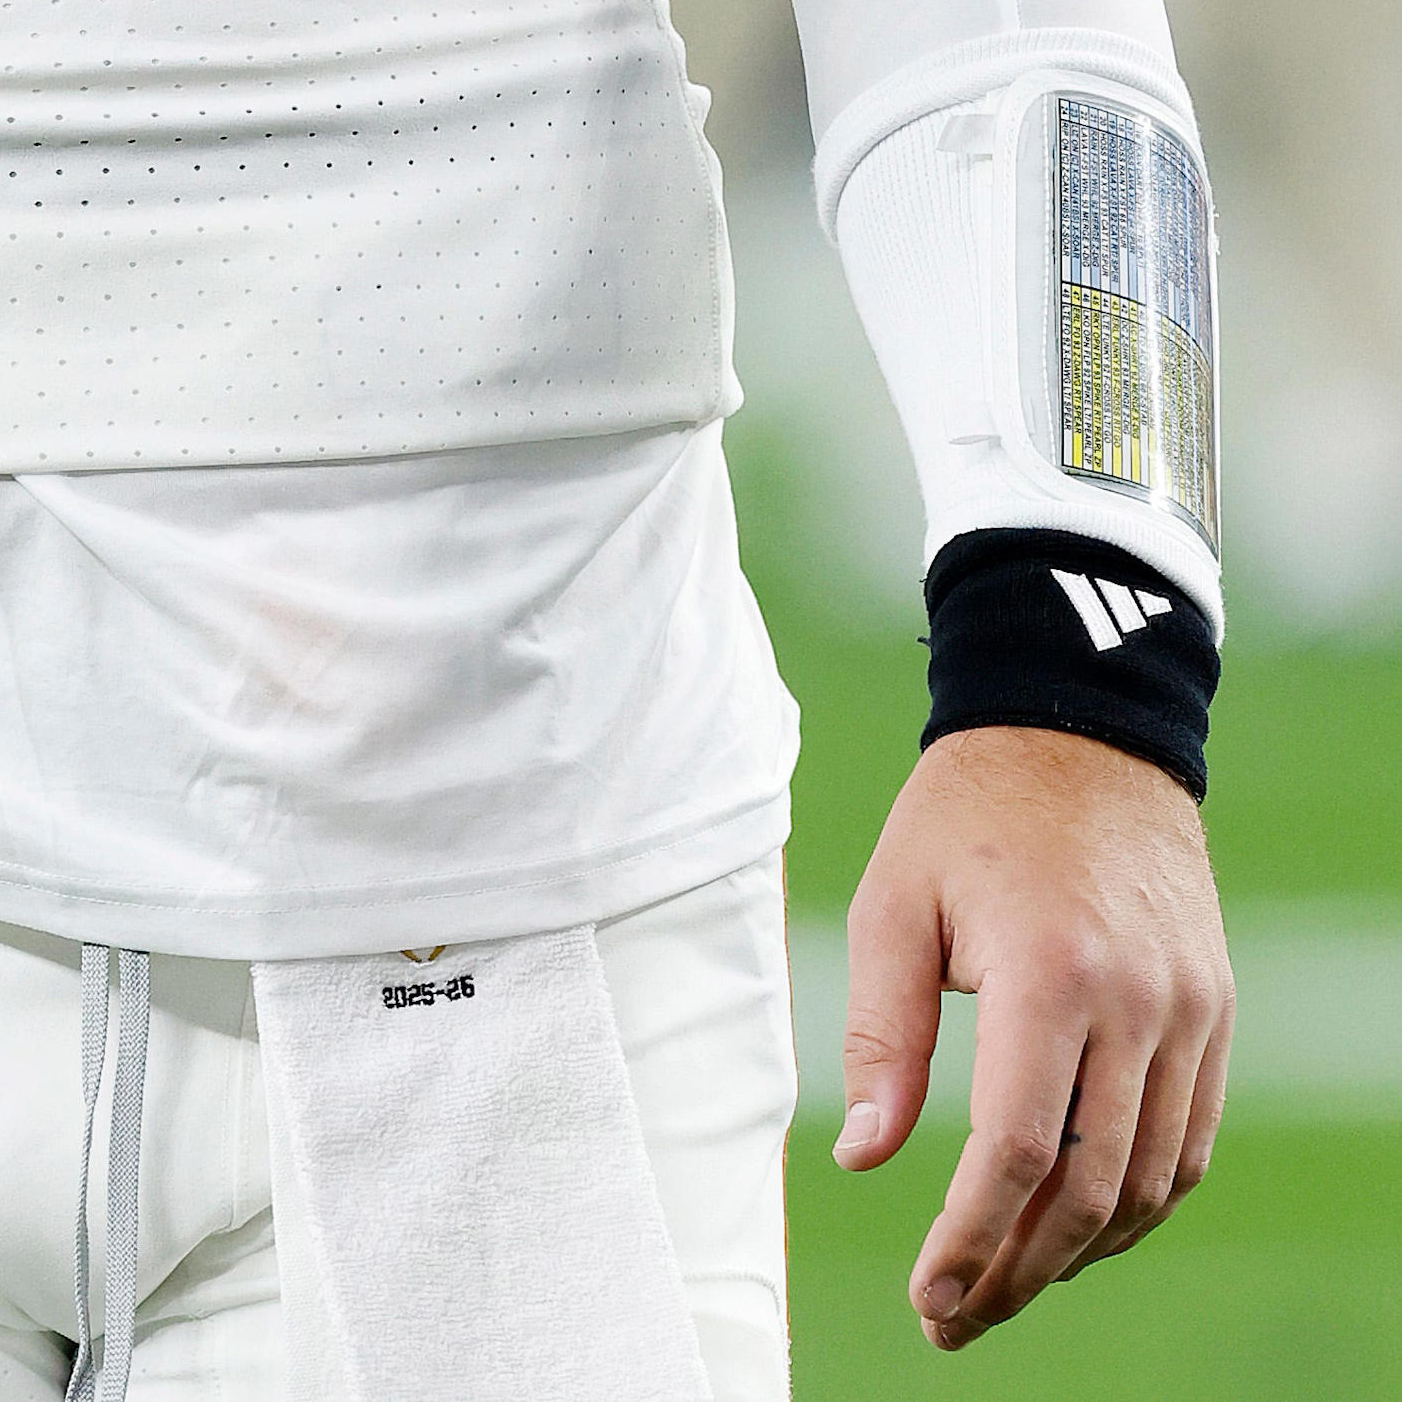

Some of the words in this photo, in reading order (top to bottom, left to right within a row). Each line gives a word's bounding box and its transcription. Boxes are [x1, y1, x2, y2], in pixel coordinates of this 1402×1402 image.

[1062, 106, 1070, 115] 24
[1081, 111, 1089, 121] 22
[1062, 123, 1070, 137] RIP
[1081, 128, 1089, 150] LAVA
[1062, 139, 1070, 152] ON
[1072, 140, 1080, 153] ON
[1091, 130, 1099, 152] RAIN
[1100, 133, 1108, 157] HOSS
[1100, 159, 1108, 180] RAIN
[1110, 161, 1118, 184] LAVA
[1119, 164, 1127, 185] RAIN
[1062, 166, 1070, 194] Z-CAN
[1072, 168, 1080, 195] X-CAN
[1082, 211, 1090, 241] MERGE
[1092, 212, 1100, 241] MERGE
[1101, 219, 1109, 237] CAT
[1111, 225, 1119, 242] CAT
[1062, 224, 1070, 258] Z-SOAR
[1072, 225, 1080, 260] X-SOAR
[1082, 243, 1090, 268] X-DIG
[1101, 253, 1109, 277] SPUR
[1063, 288, 1071, 299] 48
[1073, 291, 1081, 301] 47
[1093, 296, 1101, 306] 45
[1103, 299, 1110, 308] 44
[1063, 305, 1071, 321] LTE
[1073, 307, 1081, 324] ERL
[1112, 301, 1120, 311] 43
[1121, 304, 1129, 314] 42
[1083, 309, 1091, 328] LKO
[1093, 312, 1101, 331] RKY
[1063, 324, 1071, 336] FO
[1083, 330, 1091, 350] OPN
[1063, 338, 1071, 348] 92
[1093, 332, 1101, 351] OPN
[1063, 349, 1071, 385] X-DAWG
[1074, 351, 1082, 387] Z-DAWG
[1084, 380, 1092, 406] SPIKE
[1094, 382, 1102, 408] SPIKE
[1122, 379, 1130, 409] MERGE
[1063, 401, 1072, 431] SPEAR
[1074, 405, 1082, 434] SPEAR
[1084, 422, 1092, 451] PEARL
[1094, 425, 1102, 454] PEARL
[1104, 430, 1111, 444] GO
[1114, 434, 1122, 449] GO
[1084, 452, 1092, 465] ZP
[1094, 456, 1102, 469] ZP
[382, 973, 476, 1010] 2025-26
